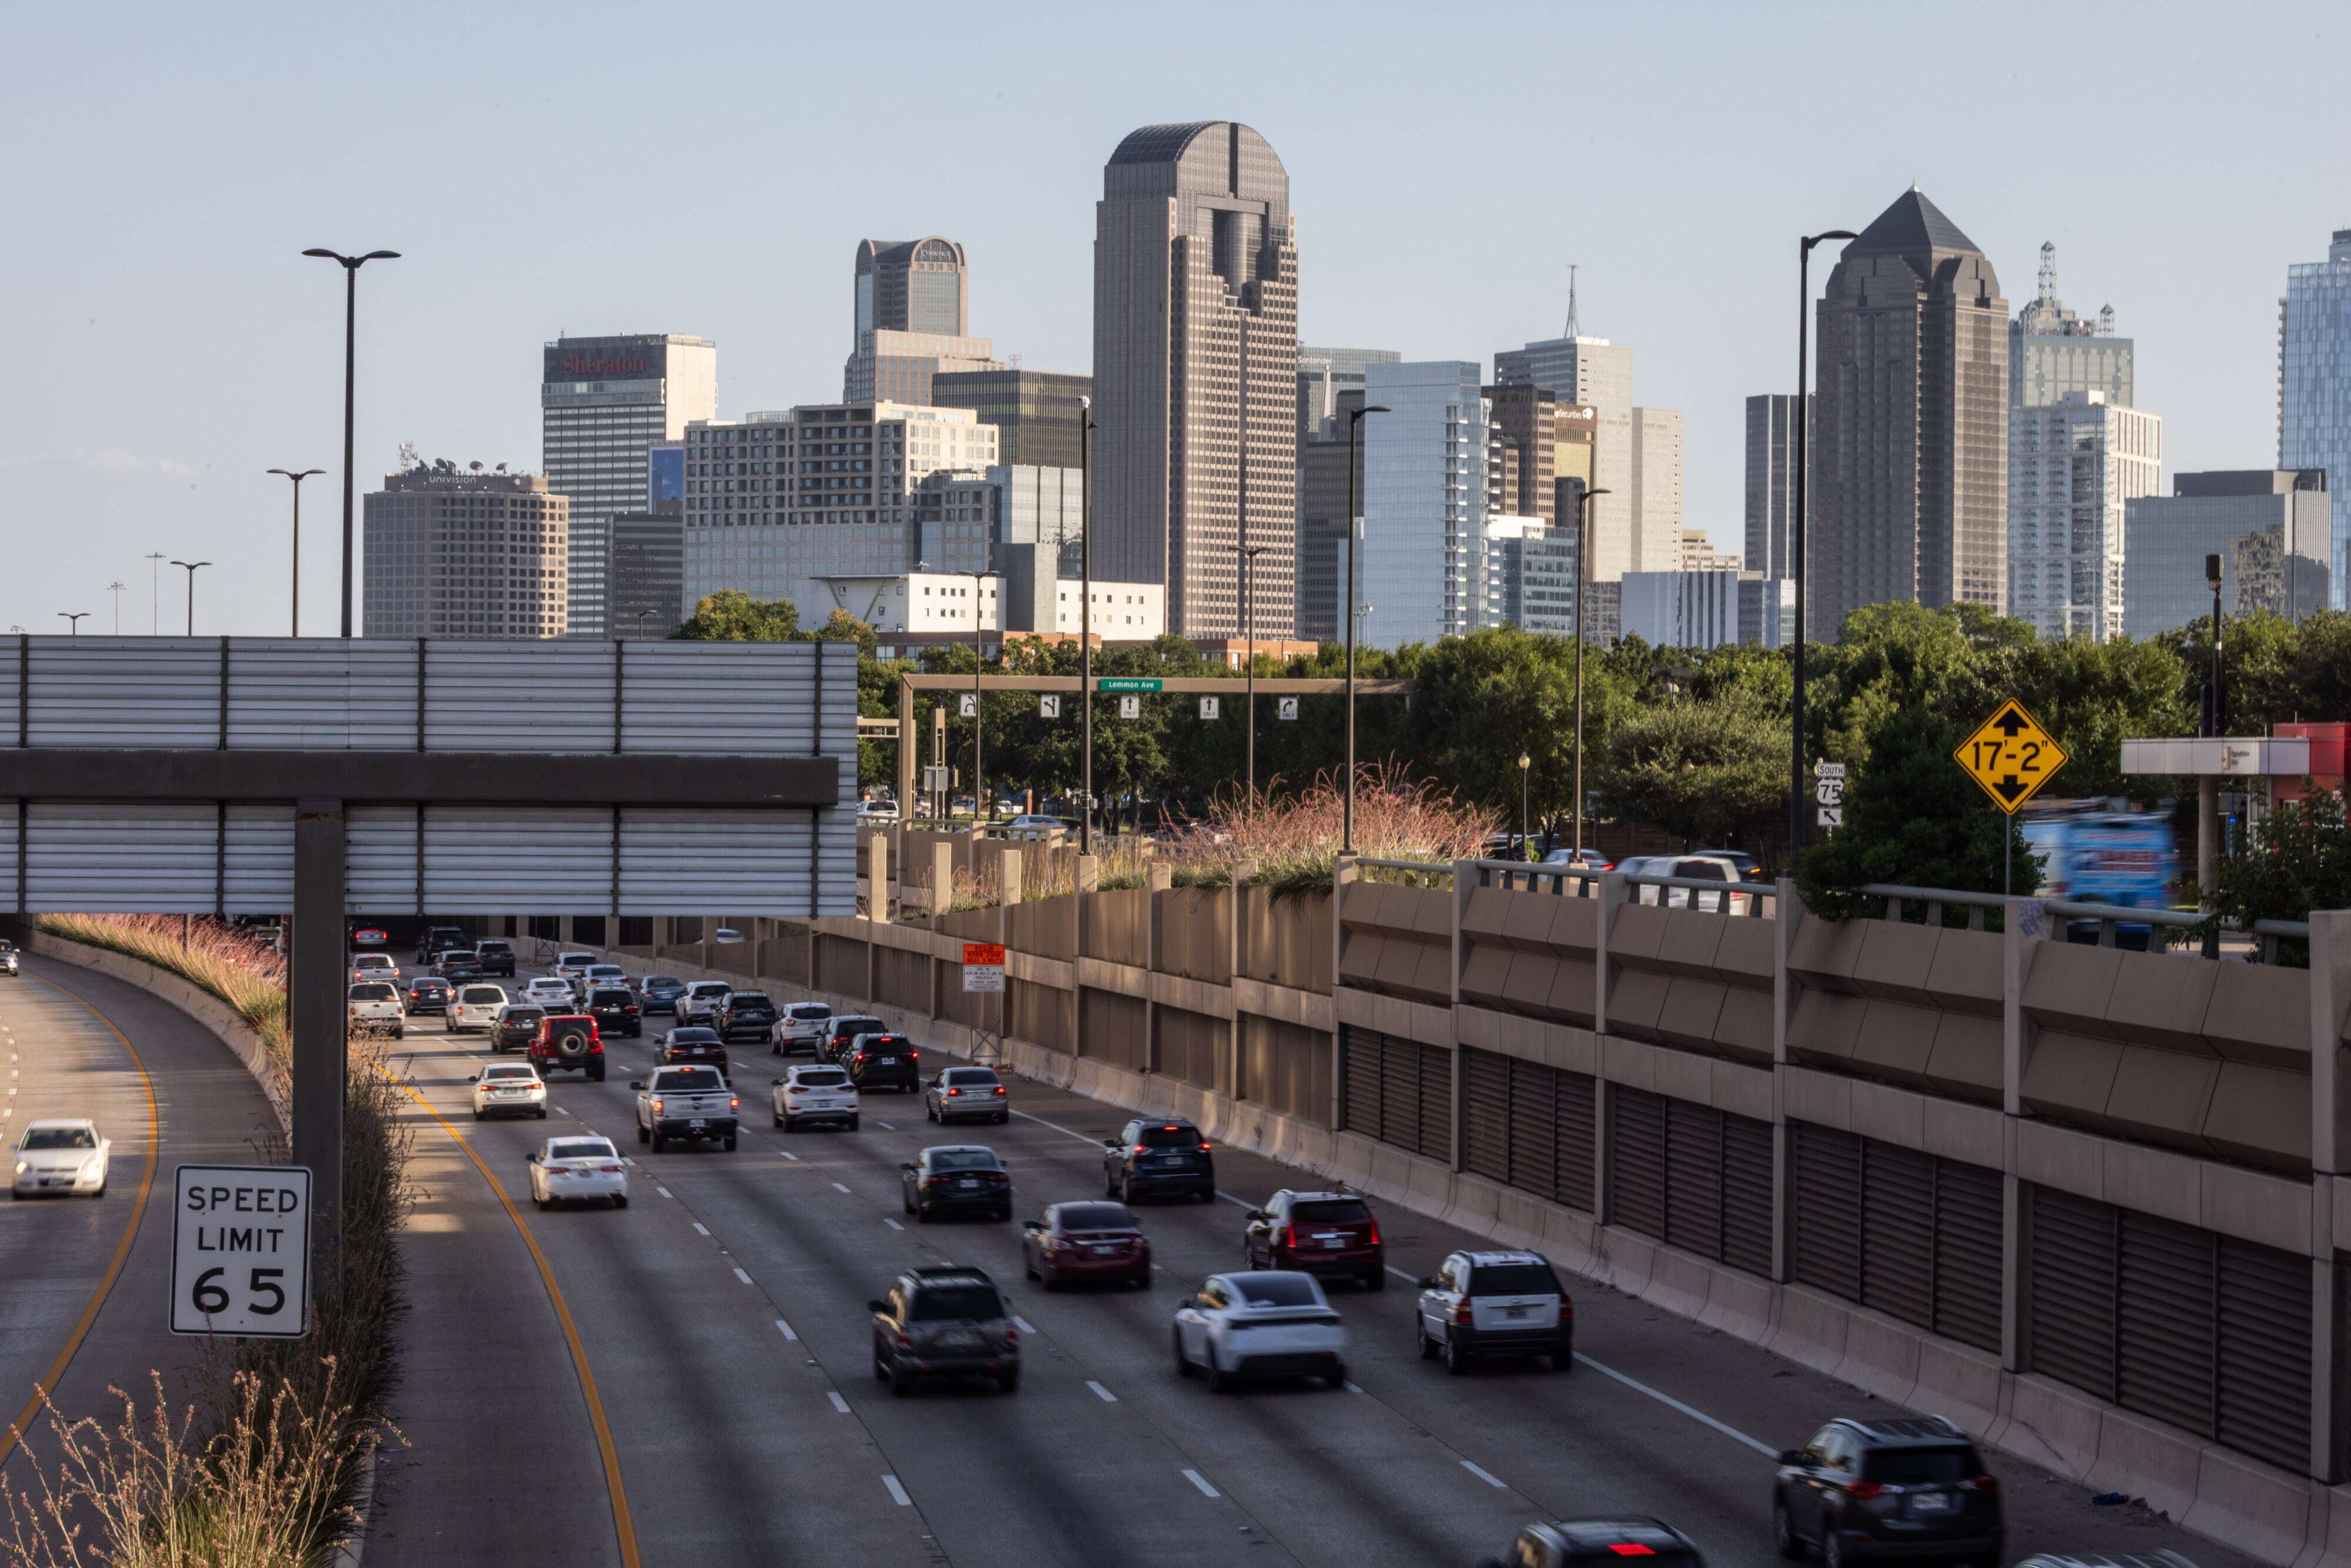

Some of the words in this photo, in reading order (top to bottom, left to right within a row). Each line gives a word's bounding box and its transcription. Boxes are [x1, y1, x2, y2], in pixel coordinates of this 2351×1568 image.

[564, 356, 645, 376] Sheraton
[1820, 765, 1843, 775] SOUTH
[1820, 784, 1841, 800] 75
[187, 1186, 298, 1213] SPEED
[198, 1227, 284, 1252] LIMIT
[192, 1267, 286, 1315] 65
